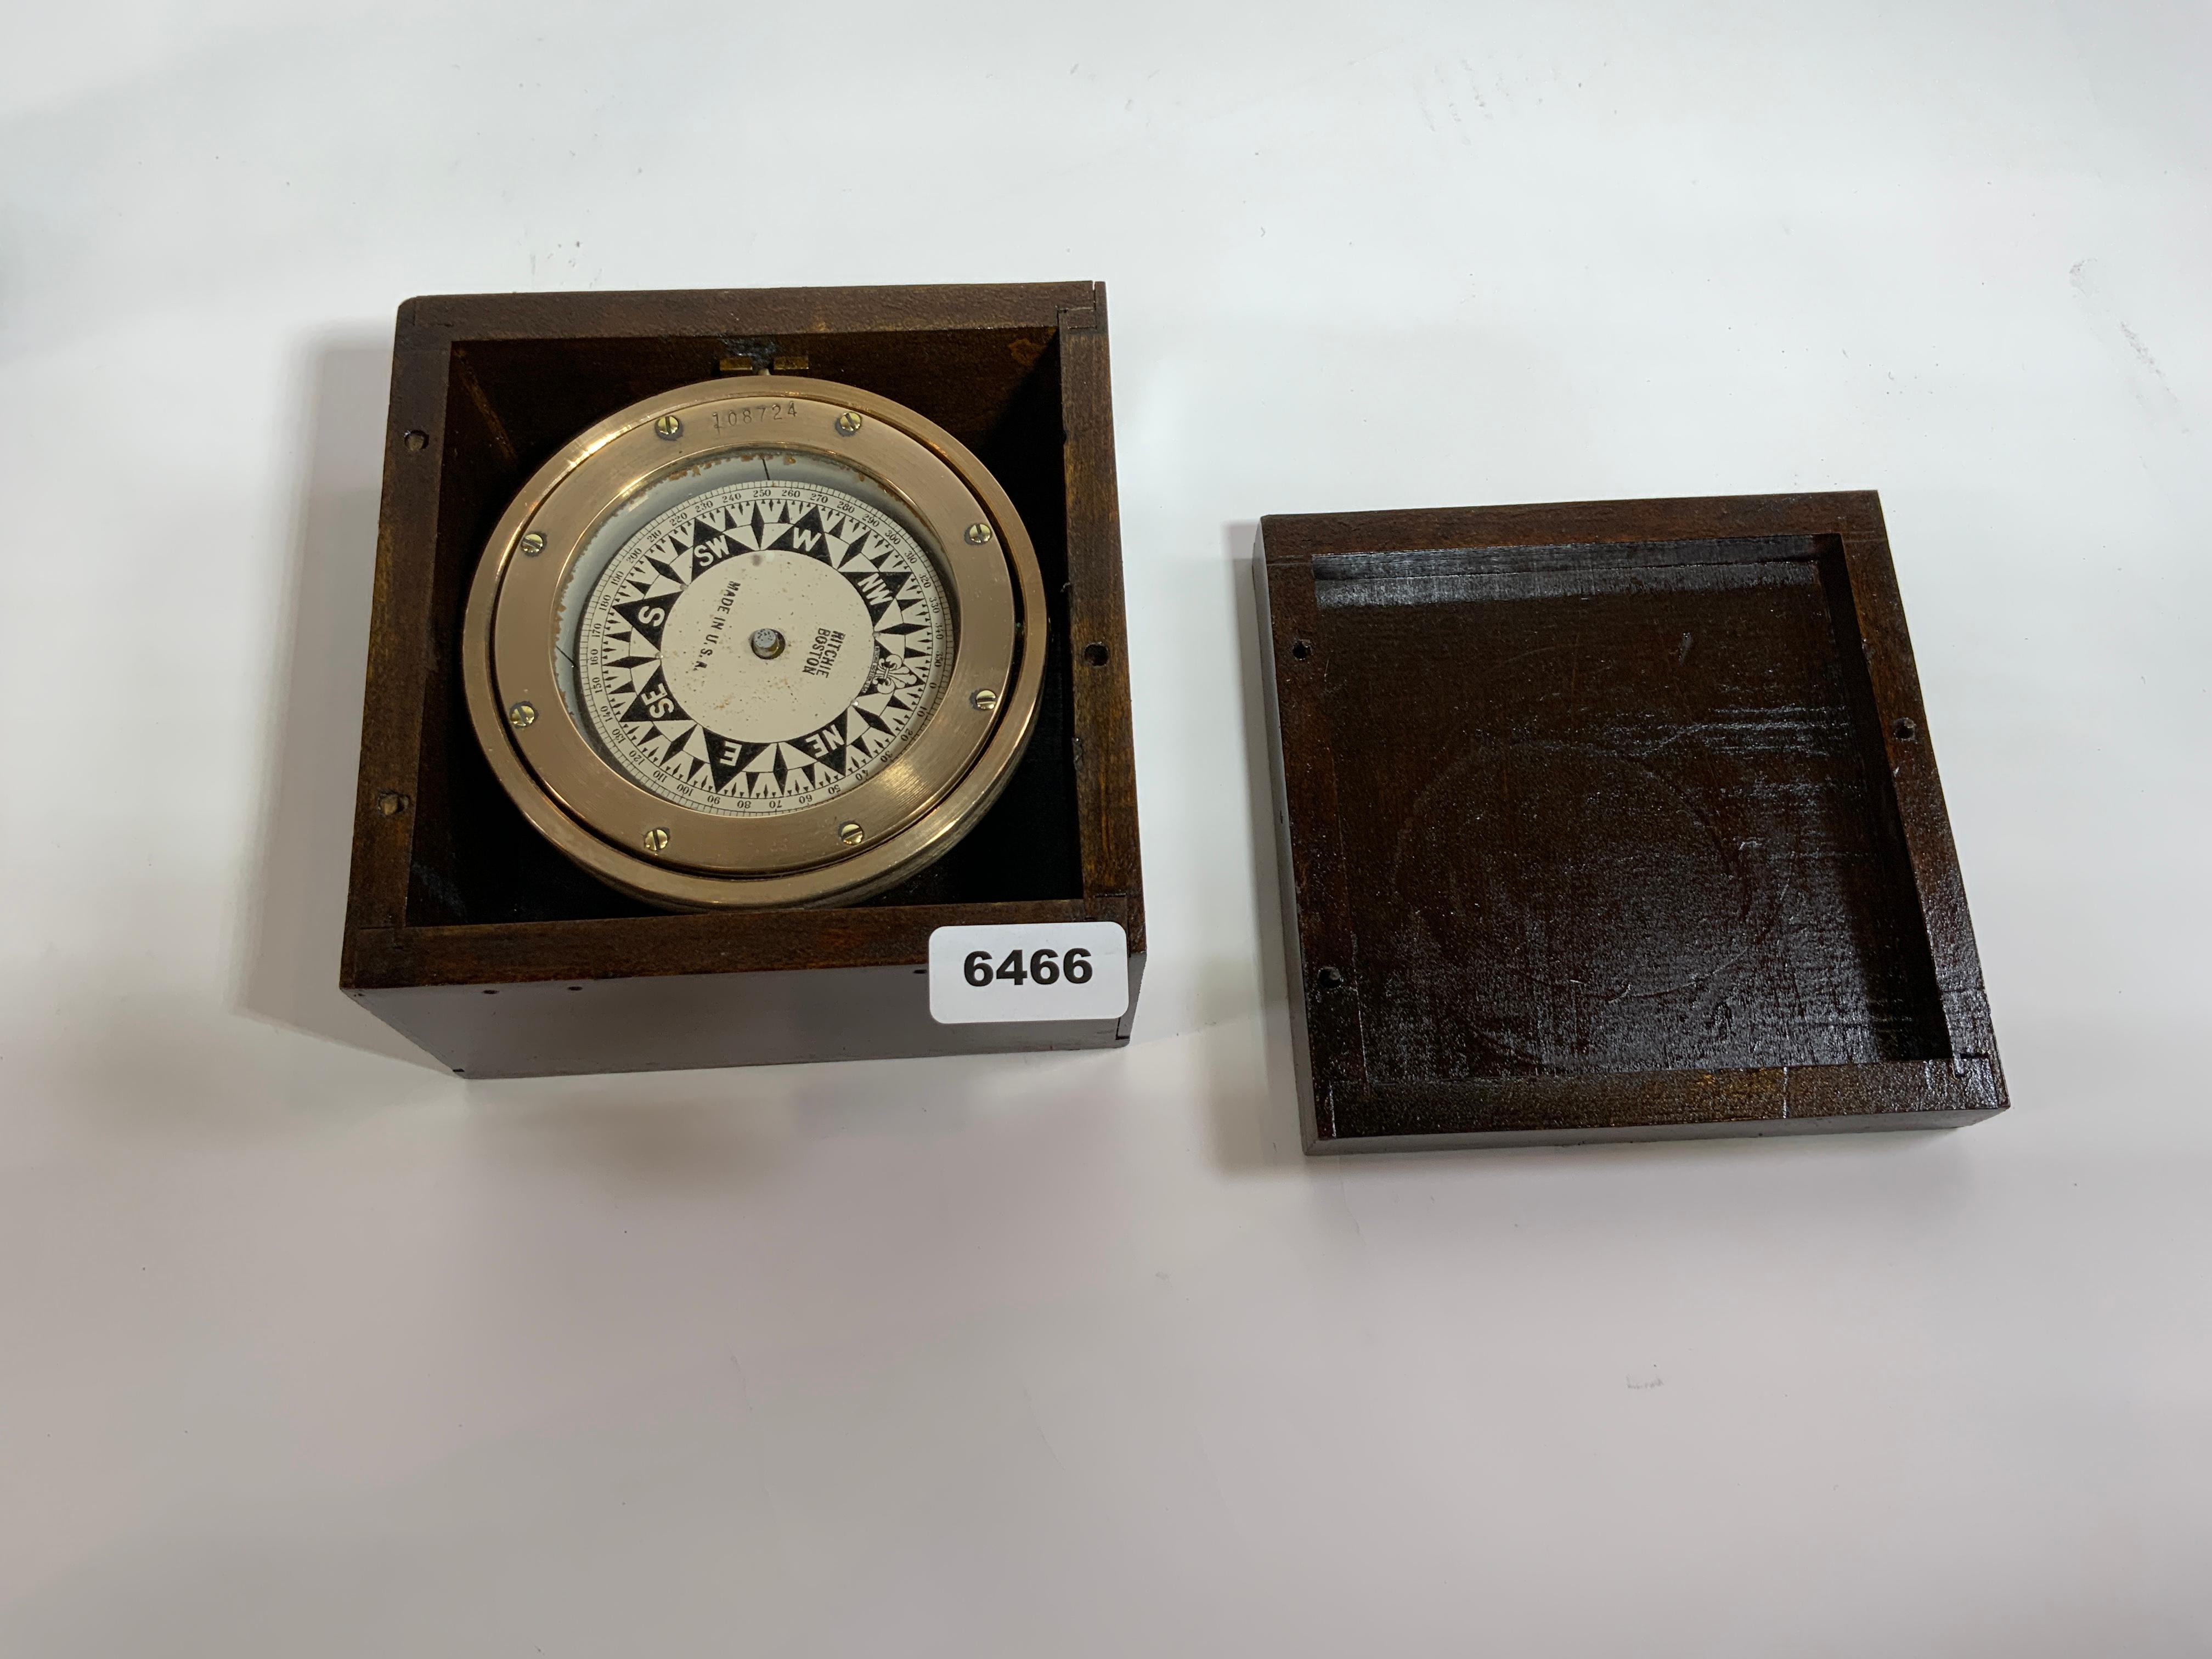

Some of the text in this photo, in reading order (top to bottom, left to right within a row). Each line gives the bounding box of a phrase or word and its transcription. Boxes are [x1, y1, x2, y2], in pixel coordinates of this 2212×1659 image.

[712, 400, 797, 430] 108724
[722, 493, 741, 503] 240
[782, 489, 800, 498] 260
[810, 493, 828, 503] 270
[695, 500, 713, 513] 230
[837, 501, 855, 514] 280
[669, 512, 687, 526] 220
[862, 514, 880, 527] 290
[647, 529, 662, 543] 210
[793, 527, 822, 551] W
[884, 530, 900, 545] 300
[626, 548, 642, 564] 200
[694, 534, 730, 567] SW
[905, 550, 917, 564] 310
[611, 571, 624, 585] 190
[919, 573, 932, 588] 320
[857, 573, 894, 605] NW
[599, 594, 611, 611] 180
[717, 581, 741, 614] MADE
[929, 596, 940, 613] 330
[638, 606, 665, 627] S
[710, 617, 726, 630] IN
[592, 623, 602, 638] 170
[935, 623, 944, 640] 340
[590, 648, 599, 665] 160
[802, 628, 831, 675] BOSTON
[816, 630, 846, 679] RITCHIE
[934, 651, 943, 667] 350
[592, 677, 603, 694] 150
[641, 682, 675, 719] SE
[600, 706, 613, 723] 140
[917, 706, 928, 717] 10
[612, 728, 626, 744] 130
[806, 724, 845, 758] NE
[901, 728, 913, 741] 20
[629, 750, 646, 765] 120
[720, 741, 742, 766] E
[880, 750, 893, 763] 30
[653, 770, 668, 783] 110
[855, 769, 869, 781] 40
[676, 783, 694, 797] 100
[828, 784, 841, 795] 50
[707, 795, 720, 805] 90
[737, 800, 752, 809] 80
[769, 800, 783, 809] 70
[799, 794, 812, 804] 60
[963, 947, 1093, 987] 6466
